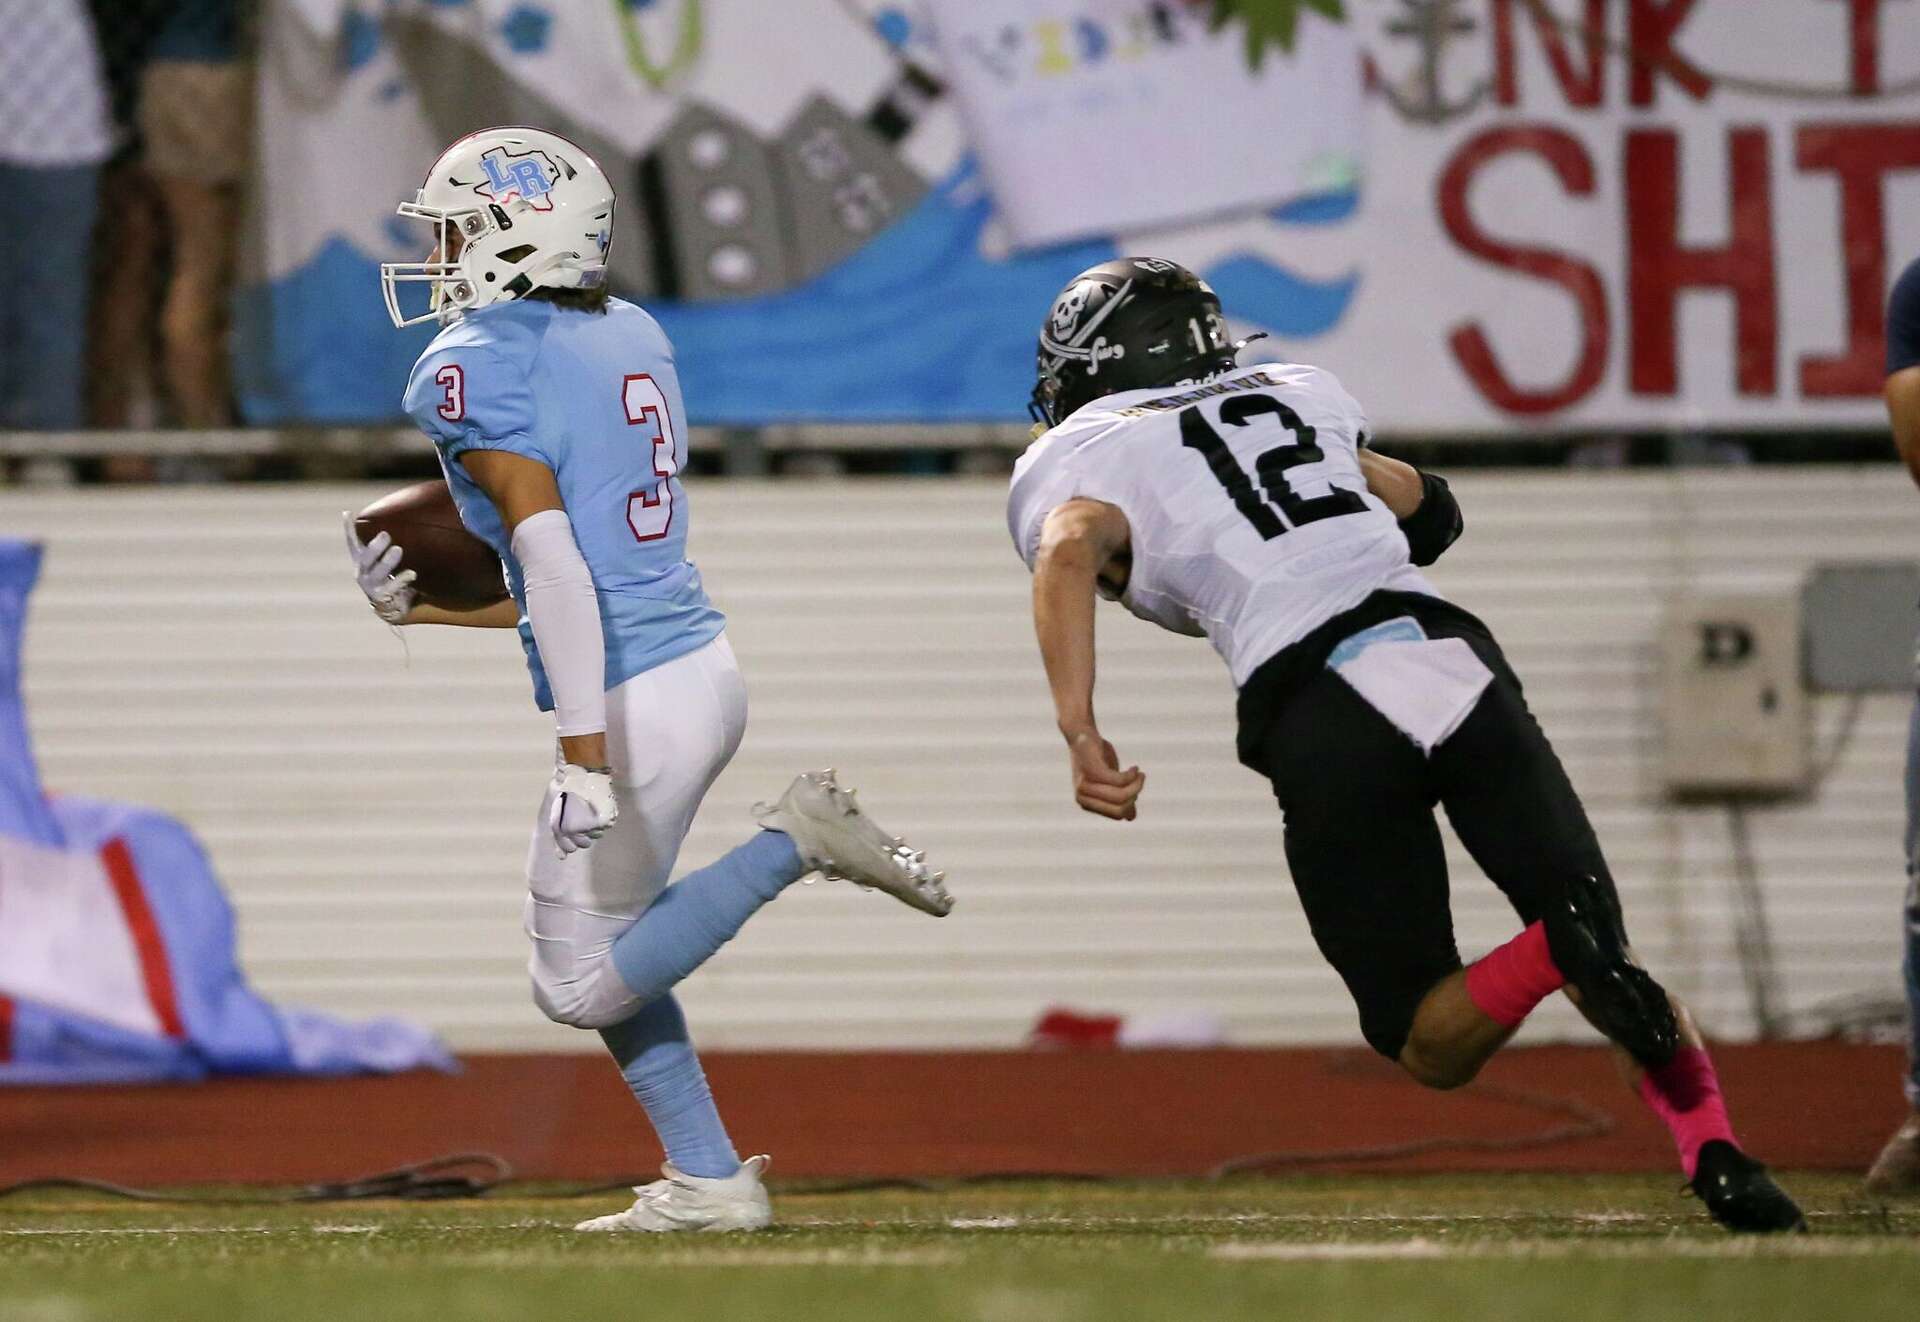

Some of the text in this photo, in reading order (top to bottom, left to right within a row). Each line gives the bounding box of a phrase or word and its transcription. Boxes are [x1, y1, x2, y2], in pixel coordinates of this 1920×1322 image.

[480, 155, 554, 200] LR
[1437, 121, 1920, 414] SHI
[1188, 313, 1231, 355] 12
[435, 364, 465, 423] 3
[622, 373, 679, 543] 3
[1179, 393, 1372, 542] 12
